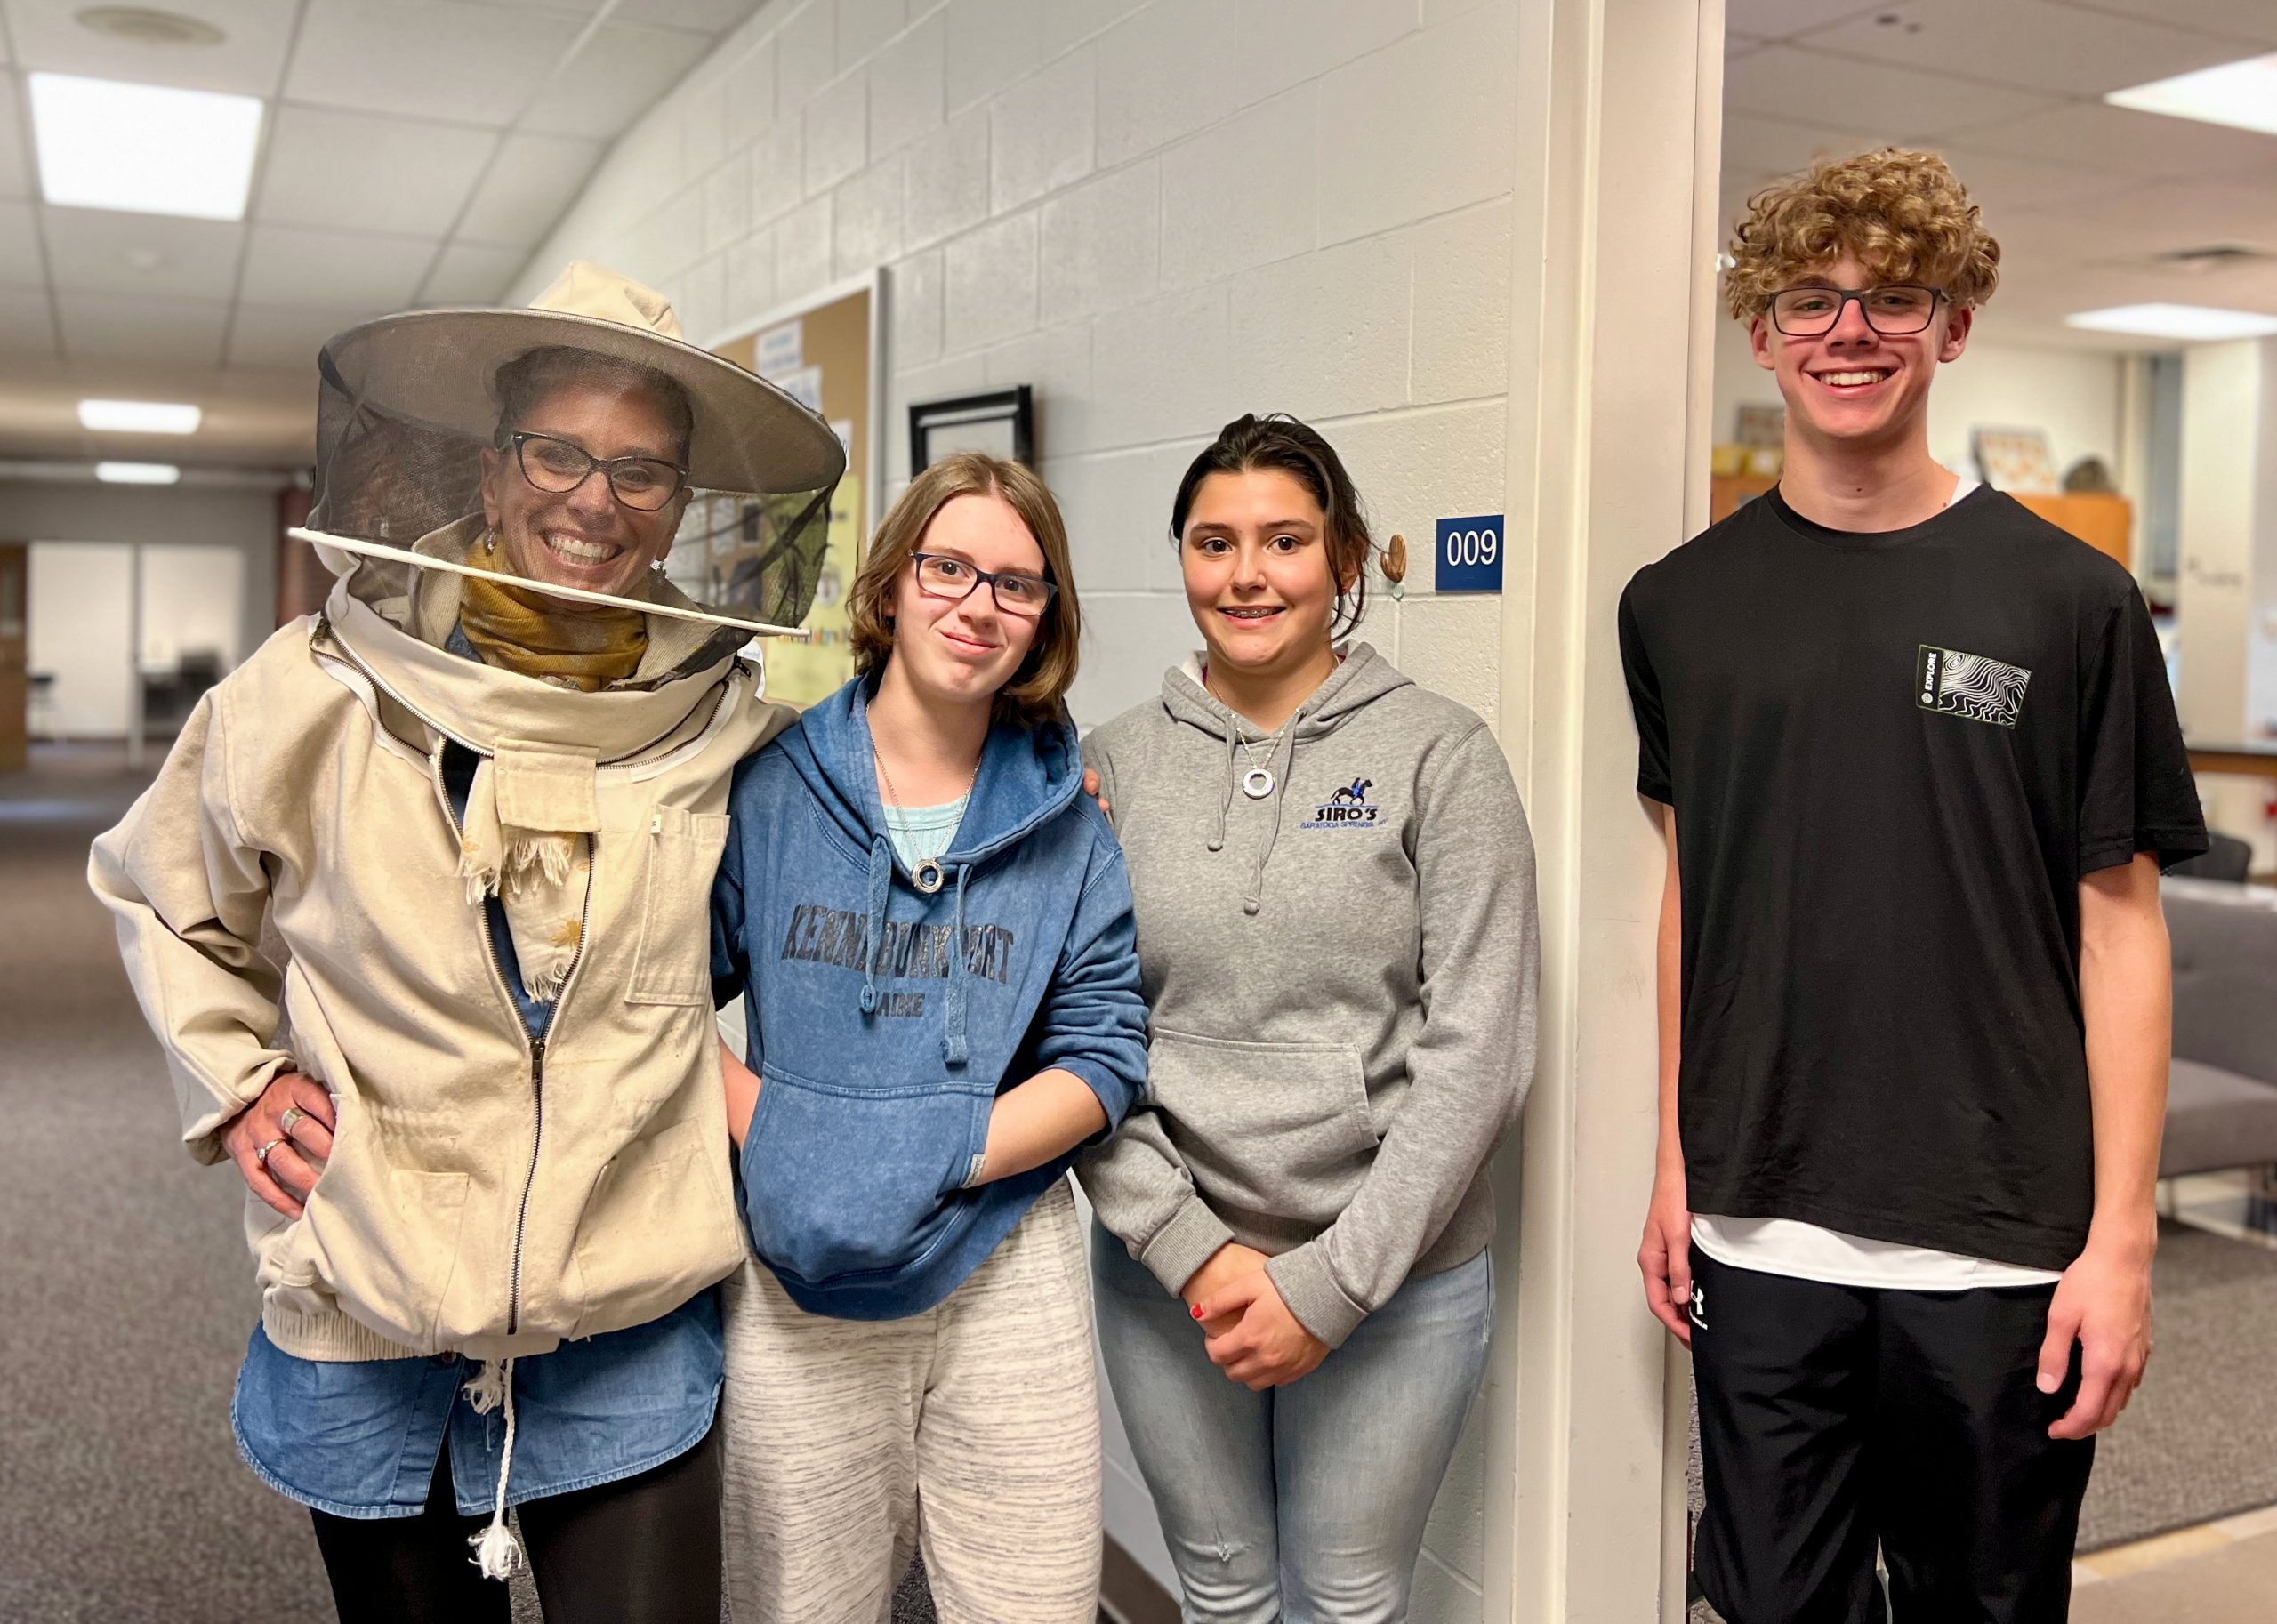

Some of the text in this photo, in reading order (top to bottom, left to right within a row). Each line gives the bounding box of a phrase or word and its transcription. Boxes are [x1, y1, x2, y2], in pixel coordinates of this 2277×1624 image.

[1446, 529, 1497, 567] 009
[1925, 652, 1937, 691] EXPLORE
[1315, 807, 1378, 822] SIRO'S
[875, 992, 926, 1017] AINE
